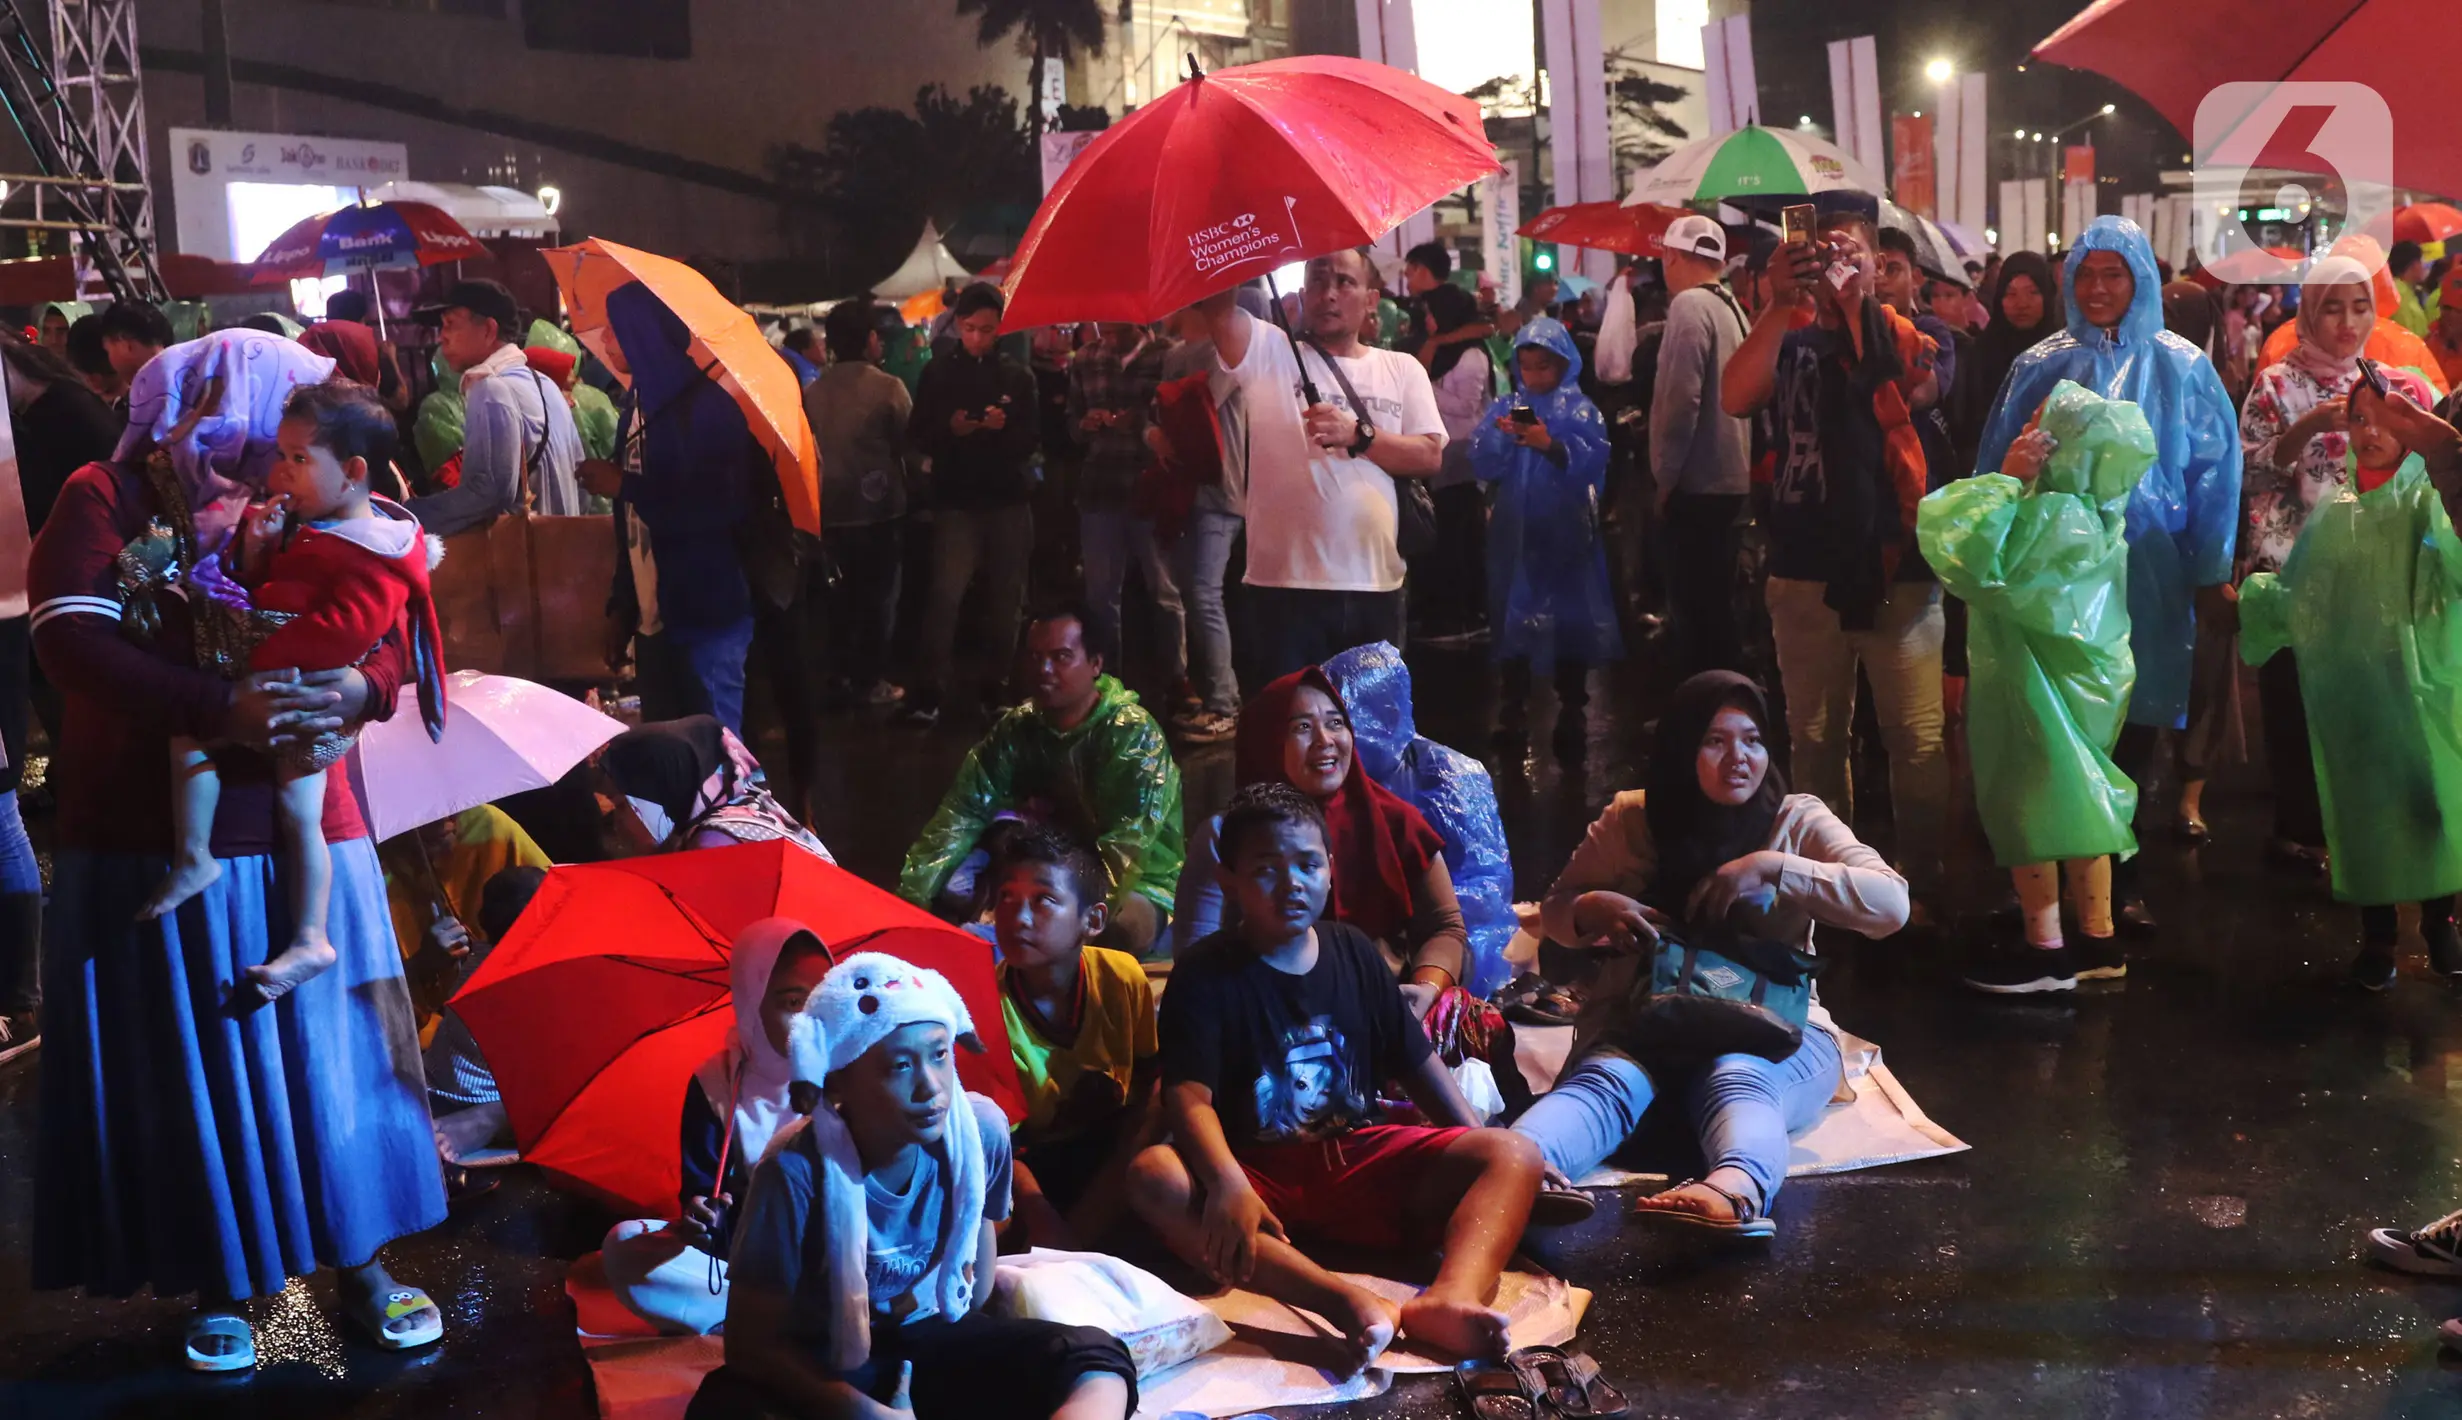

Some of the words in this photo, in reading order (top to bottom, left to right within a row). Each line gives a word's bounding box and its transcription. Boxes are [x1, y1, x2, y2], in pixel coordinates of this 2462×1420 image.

[1737, 175, 1761, 187] IT'S
[338, 233, 393, 250] Bank
[420, 230, 471, 248] Lippo
[1187, 222, 1230, 247] HSBC
[1190, 225, 1261, 260] Women's
[262, 245, 310, 264] Lippo
[1195, 232, 1280, 271] Champions
